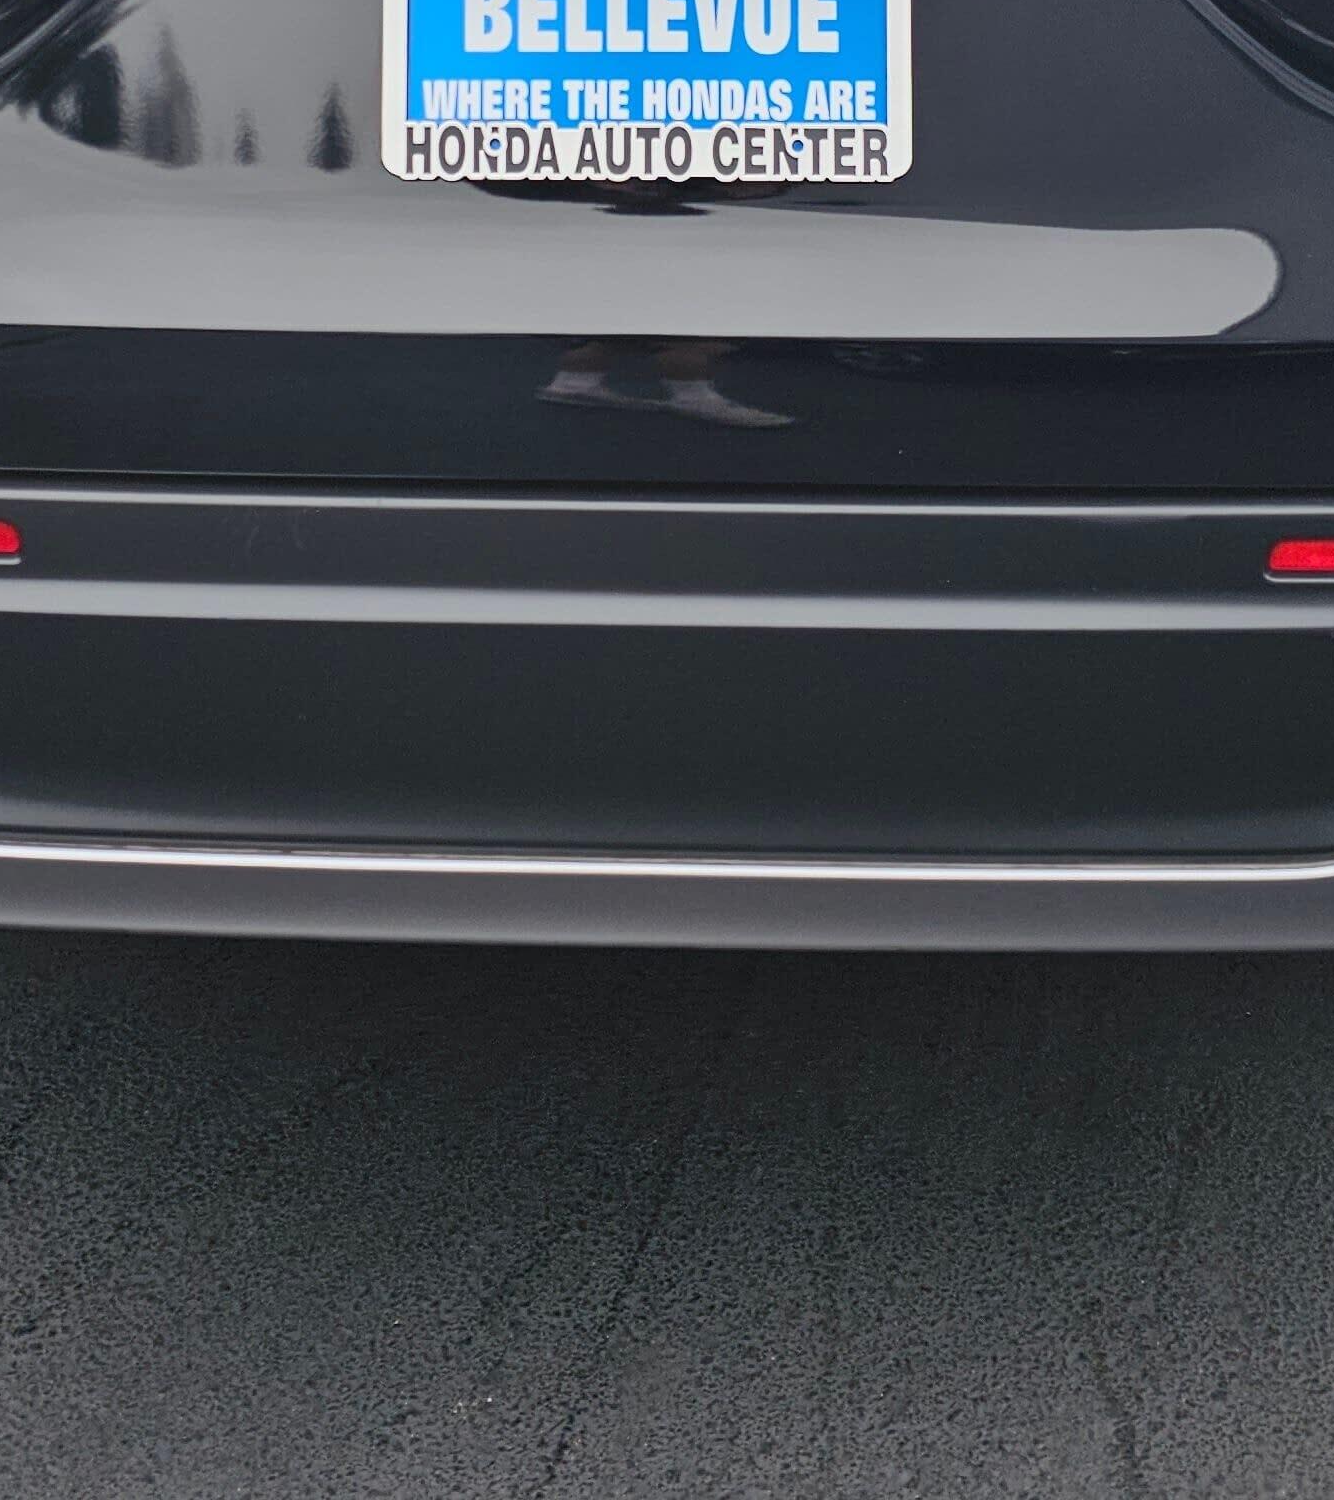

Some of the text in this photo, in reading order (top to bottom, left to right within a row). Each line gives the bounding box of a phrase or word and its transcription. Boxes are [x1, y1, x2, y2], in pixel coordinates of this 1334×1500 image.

[422, 79, 877, 122] WHERE THE HONDAS ARE
[405, 125, 890, 177] HONDA AUTO CENTER
